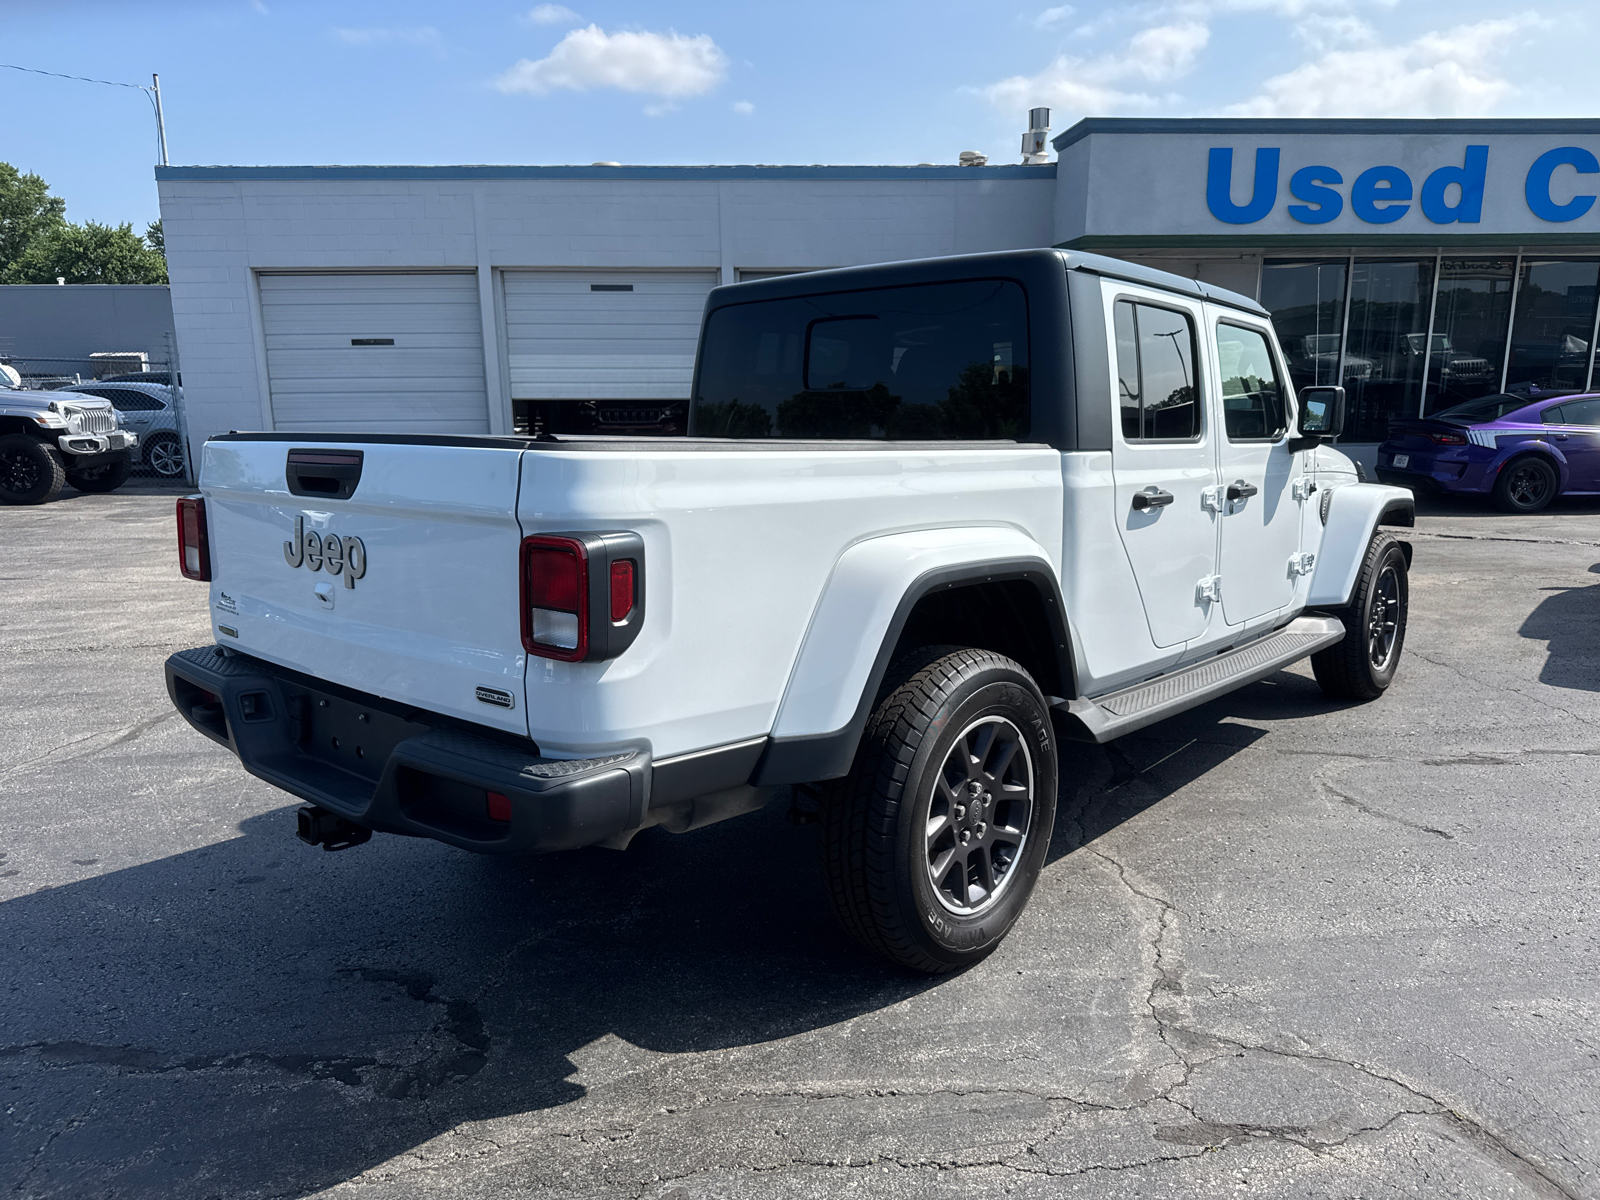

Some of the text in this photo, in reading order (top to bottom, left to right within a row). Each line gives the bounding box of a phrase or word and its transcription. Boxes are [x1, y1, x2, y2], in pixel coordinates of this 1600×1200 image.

[1206, 145, 1489, 225] Used
[284, 516, 366, 588] Jeep
[475, 690, 511, 703] OVERLAND
